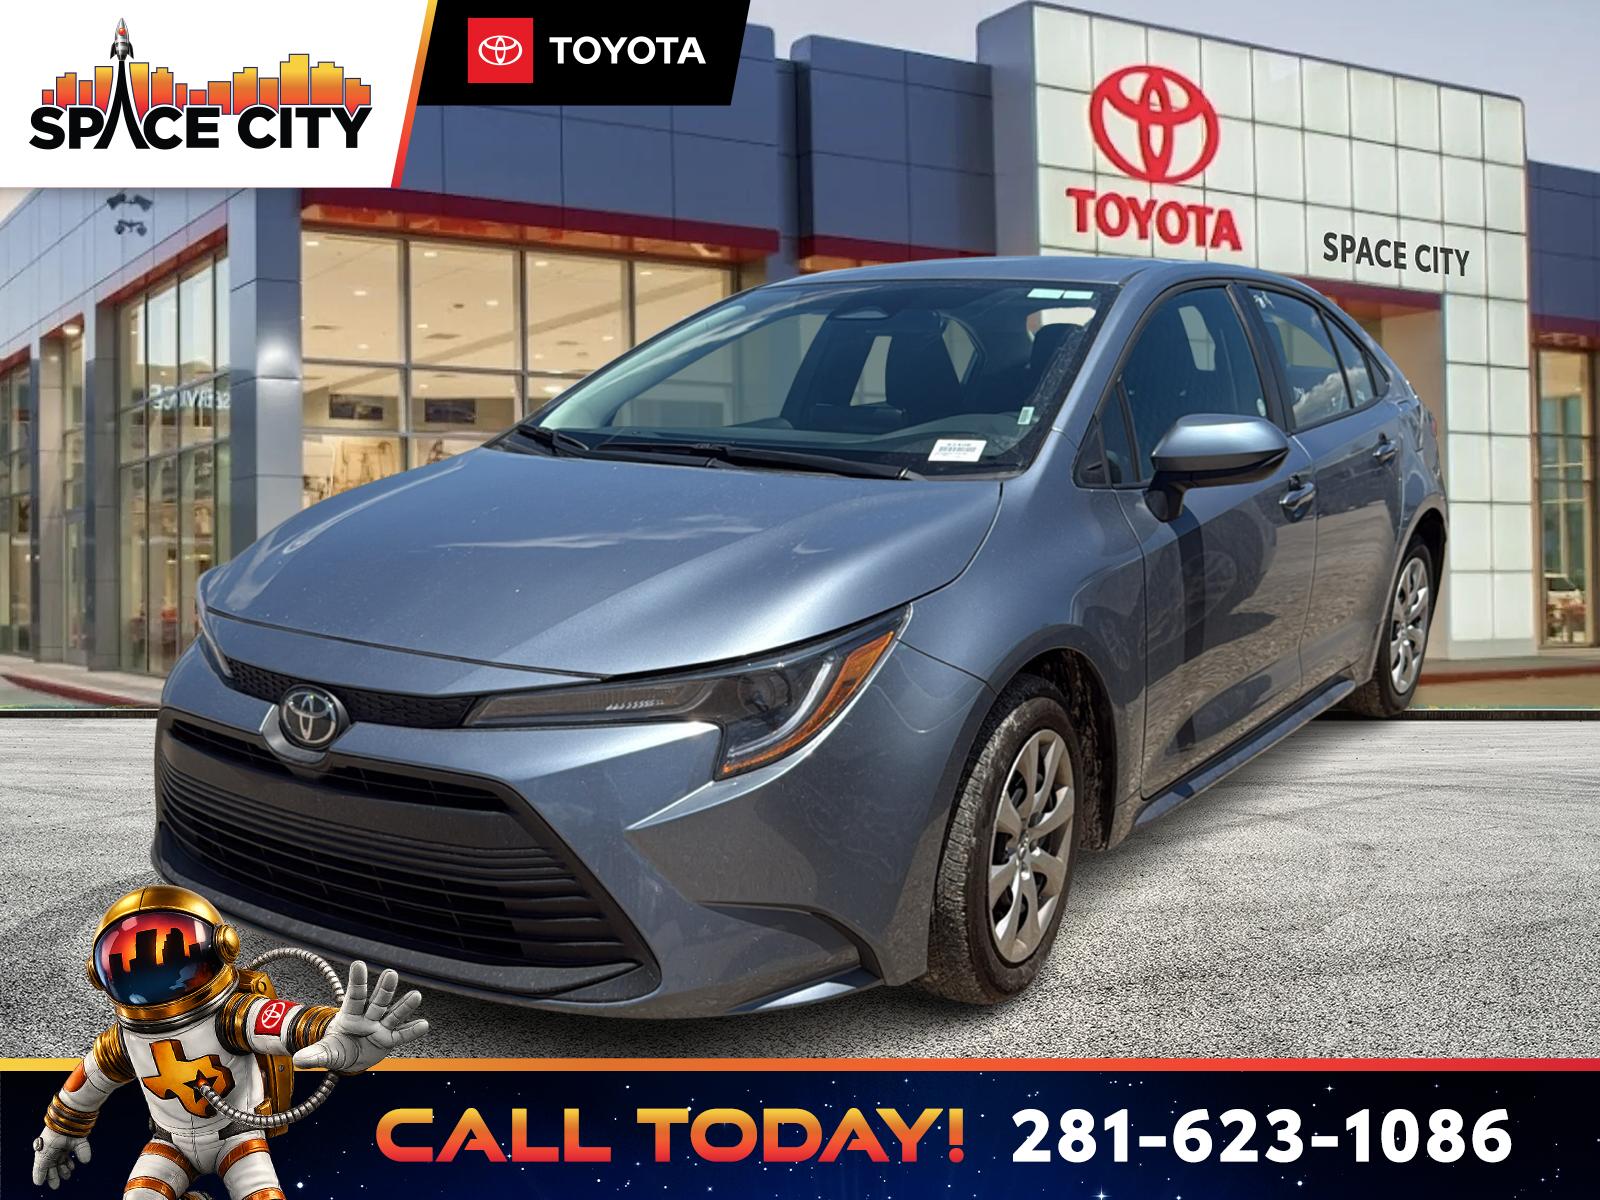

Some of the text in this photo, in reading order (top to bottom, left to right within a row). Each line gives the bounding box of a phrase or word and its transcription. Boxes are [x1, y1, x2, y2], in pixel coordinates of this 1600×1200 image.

[1066, 187, 1243, 252] TOYOTA
[1322, 231, 1470, 277] SPACE CITY
